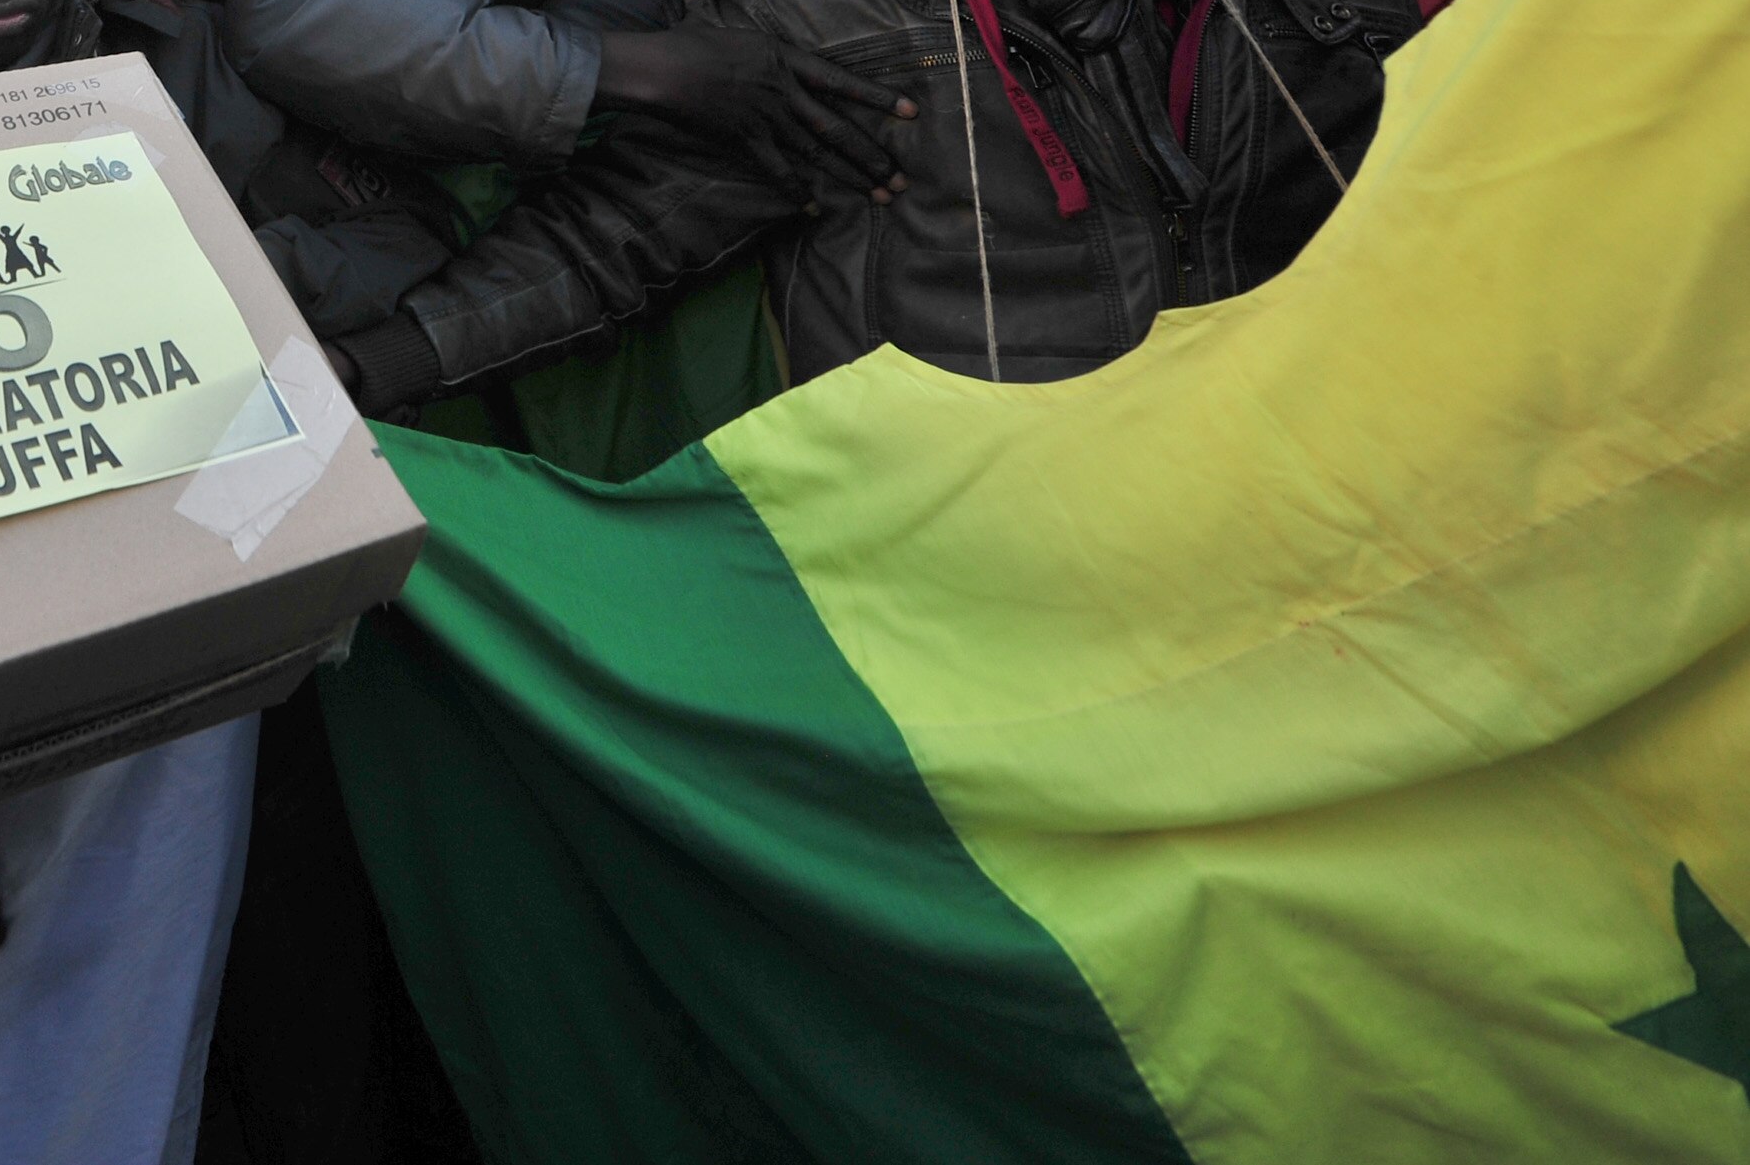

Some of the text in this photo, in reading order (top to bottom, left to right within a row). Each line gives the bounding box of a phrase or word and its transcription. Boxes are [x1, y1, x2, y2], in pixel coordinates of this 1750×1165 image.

[0, 89, 29, 104] 181
[1, 100, 107, 131] 81306171
[7, 156, 133, 203] Globale
